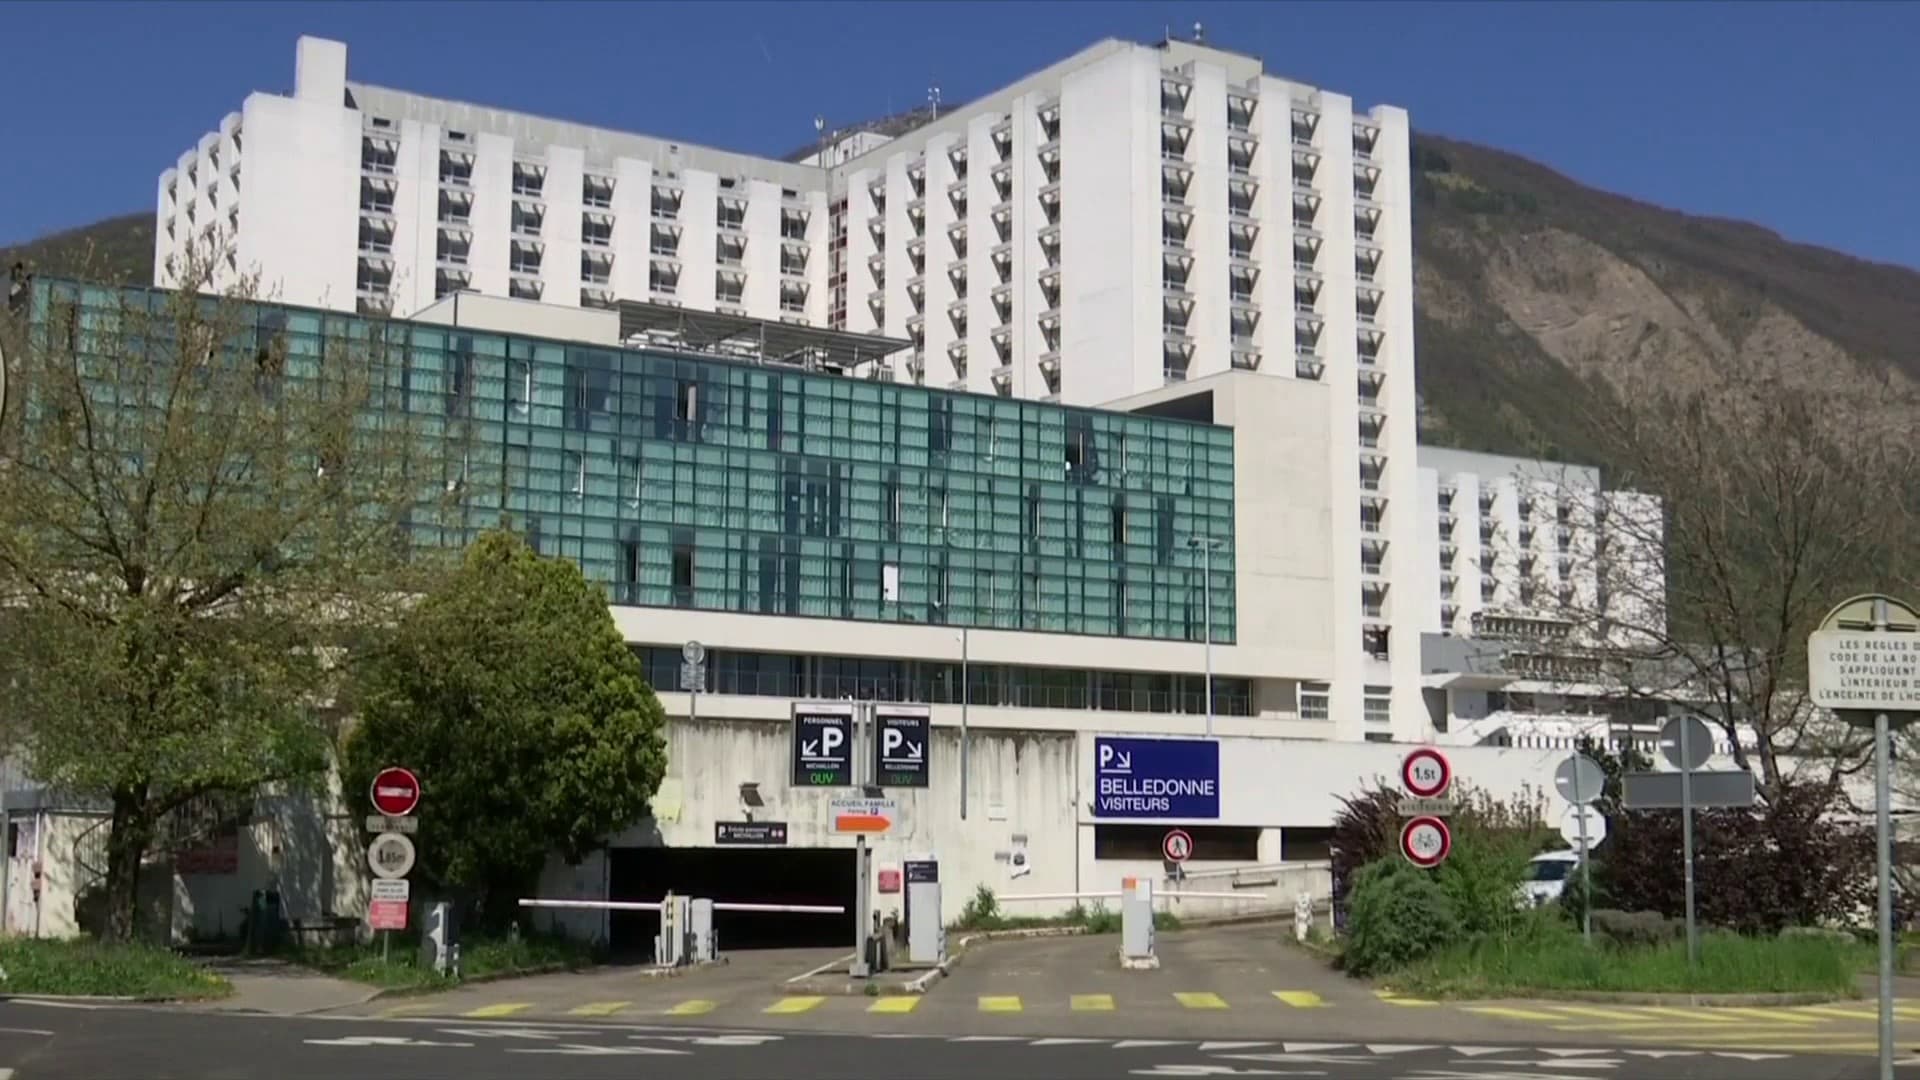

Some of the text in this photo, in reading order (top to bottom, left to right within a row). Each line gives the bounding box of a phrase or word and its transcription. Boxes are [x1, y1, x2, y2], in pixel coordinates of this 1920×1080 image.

[1840, 640, 1859, 650] LES
[1865, 641, 1907, 650] REGLES
[1830, 653, 1858, 662] CODE
[1864, 653, 1877, 662] DE
[1884, 654, 1896, 663] LA
[1881, 691, 1894, 700] DE
[1100, 778, 1214, 796] BELLEDONNE
[1100, 797, 1170, 811] VISITEURS
